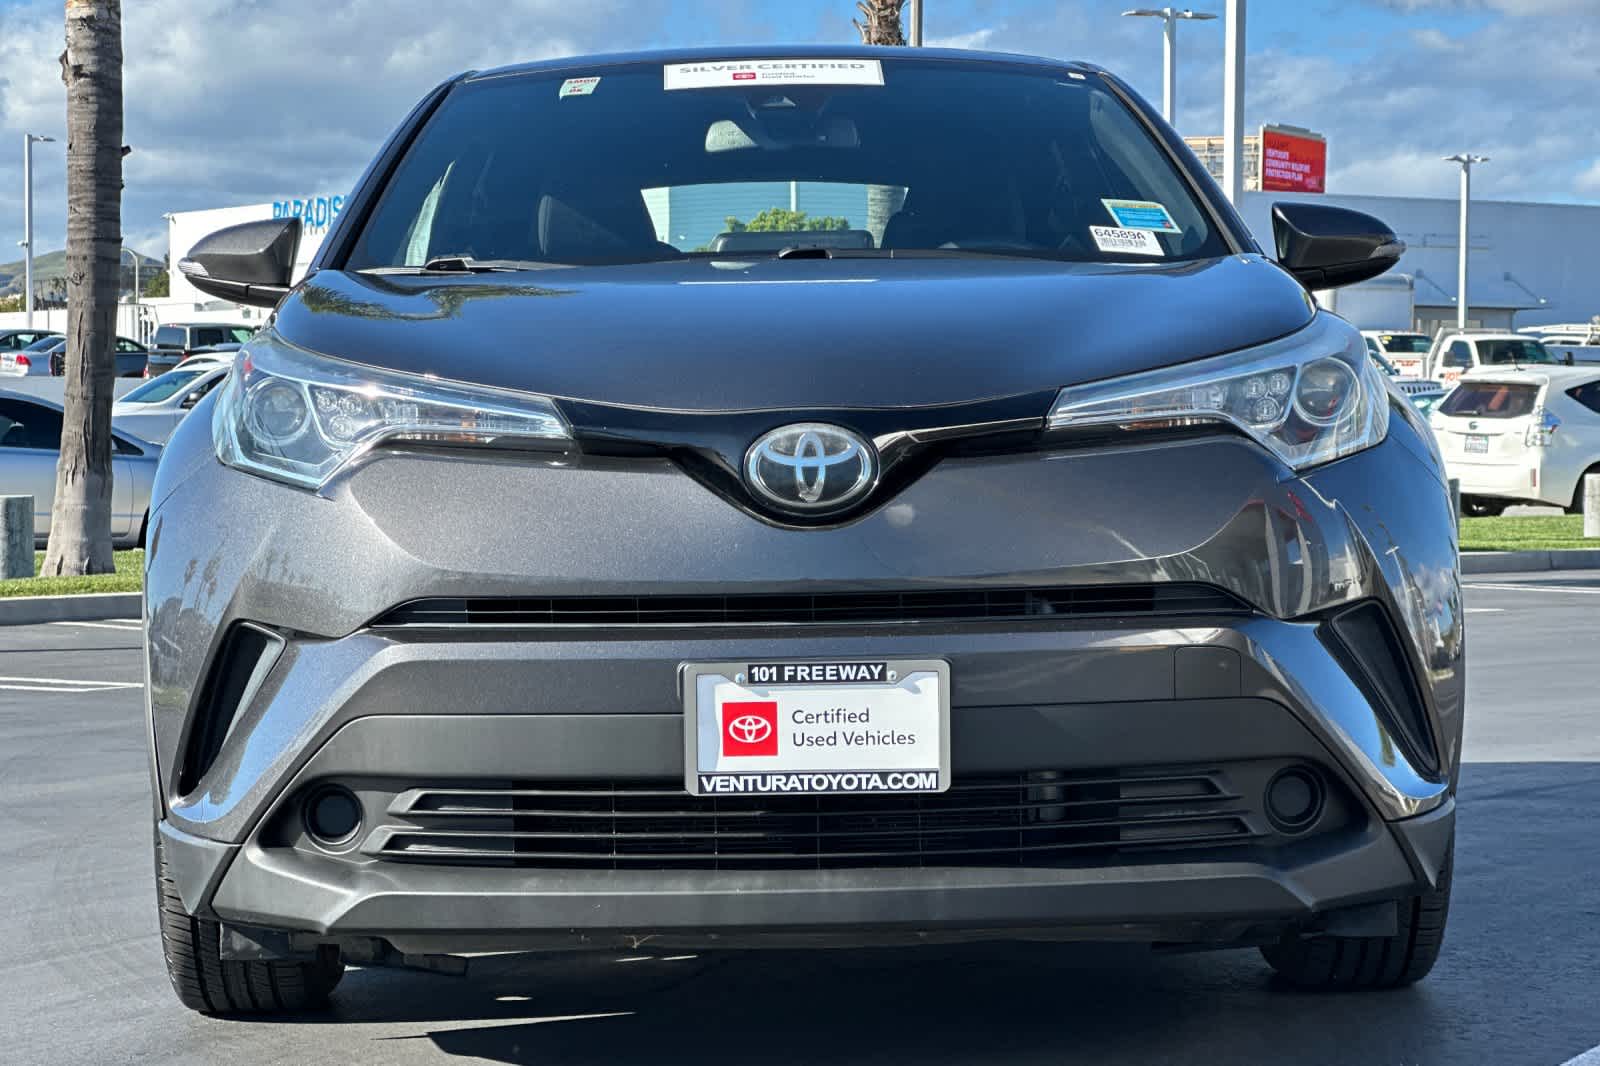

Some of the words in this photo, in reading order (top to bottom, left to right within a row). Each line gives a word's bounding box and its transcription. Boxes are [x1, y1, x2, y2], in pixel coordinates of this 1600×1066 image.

[679, 64, 751, 74] SILVER
[756, 63, 865, 71] CERTIFIED
[1094, 228, 1146, 240] 64589A
[751, 666, 777, 682] 101
[784, 665, 883, 681] FREEWAY
[791, 707, 870, 724] Certified
[792, 731, 838, 747] Used
[842, 730, 916, 747] Vehicles
[701, 773, 937, 792] VENTURATOYOTA.COM
